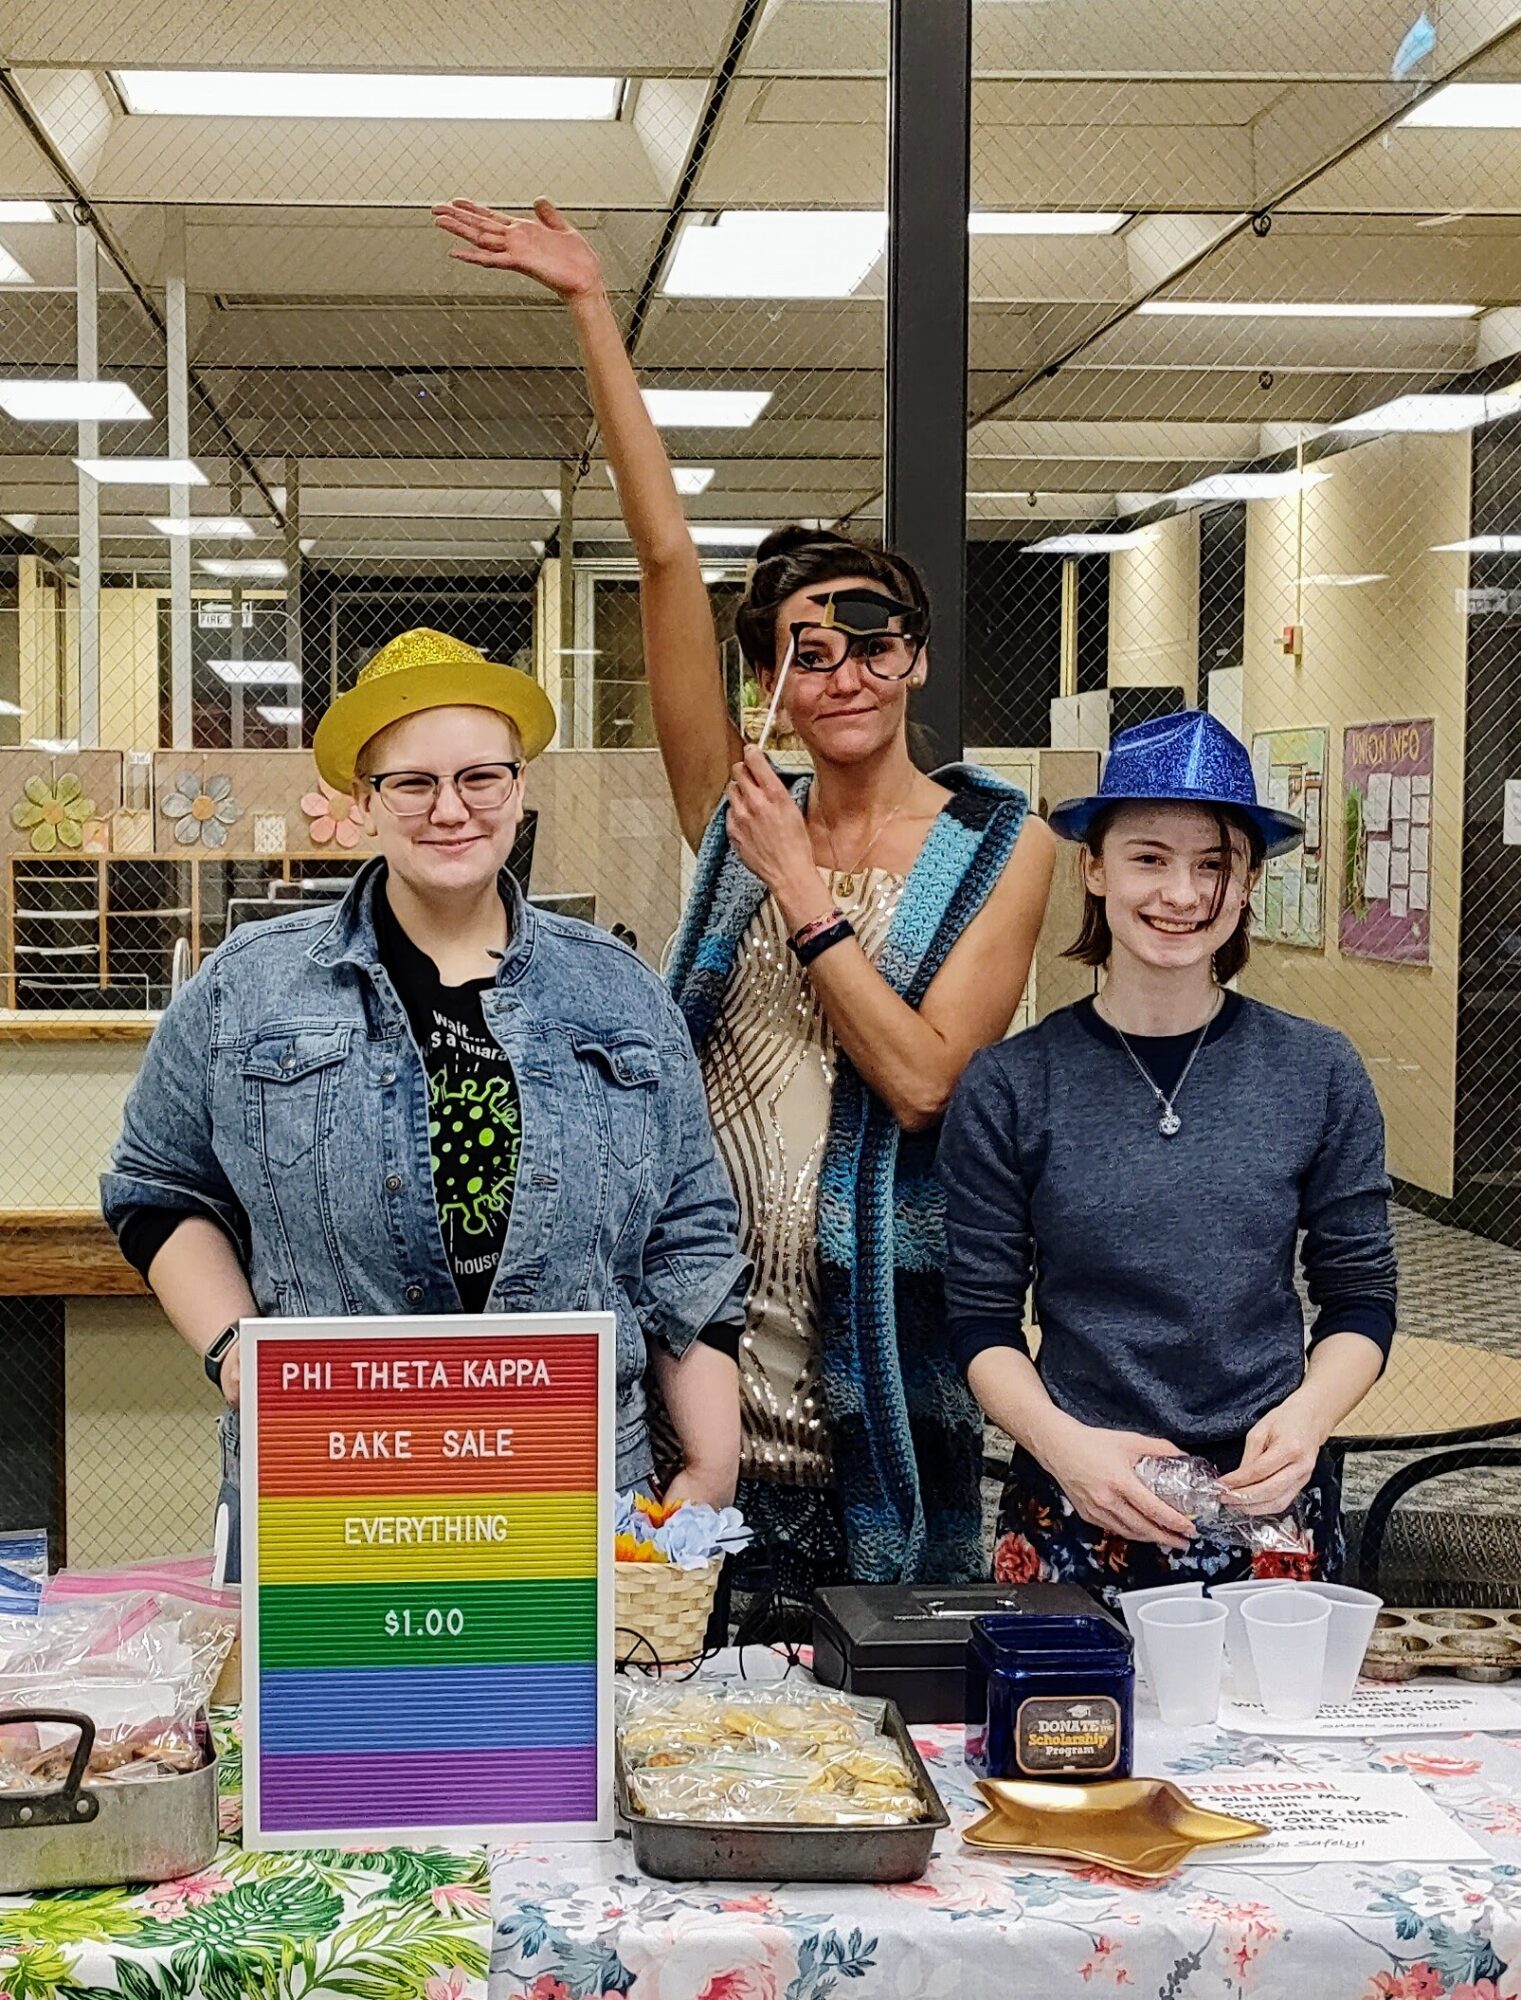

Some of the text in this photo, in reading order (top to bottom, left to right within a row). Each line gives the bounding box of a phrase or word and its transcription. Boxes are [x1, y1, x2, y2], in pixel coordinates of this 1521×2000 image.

[432, 1010, 486, 1043] wait...
[446, 1033, 457, 1048] a
[460, 1040, 508, 1061] quara
[282, 1358, 550, 1390] PHI THETA KAPPA
[328, 1428, 514, 1459] BAKE SALE
[344, 1514, 508, 1544] EVERYTHING
[384, 1607, 464, 1636] $1.00
[1038, 1720, 1099, 1733] DONATE
[1028, 1733, 1108, 1749] Scholarship
[1045, 1746, 1095, 1758] Program
[1181, 1781, 1337, 1793] TTENTION!
[1318, 1793, 1361, 1802] May
[1321, 1816, 1390, 1824] OTHER
[1347, 1810, 1408, 1819] EGGS,
